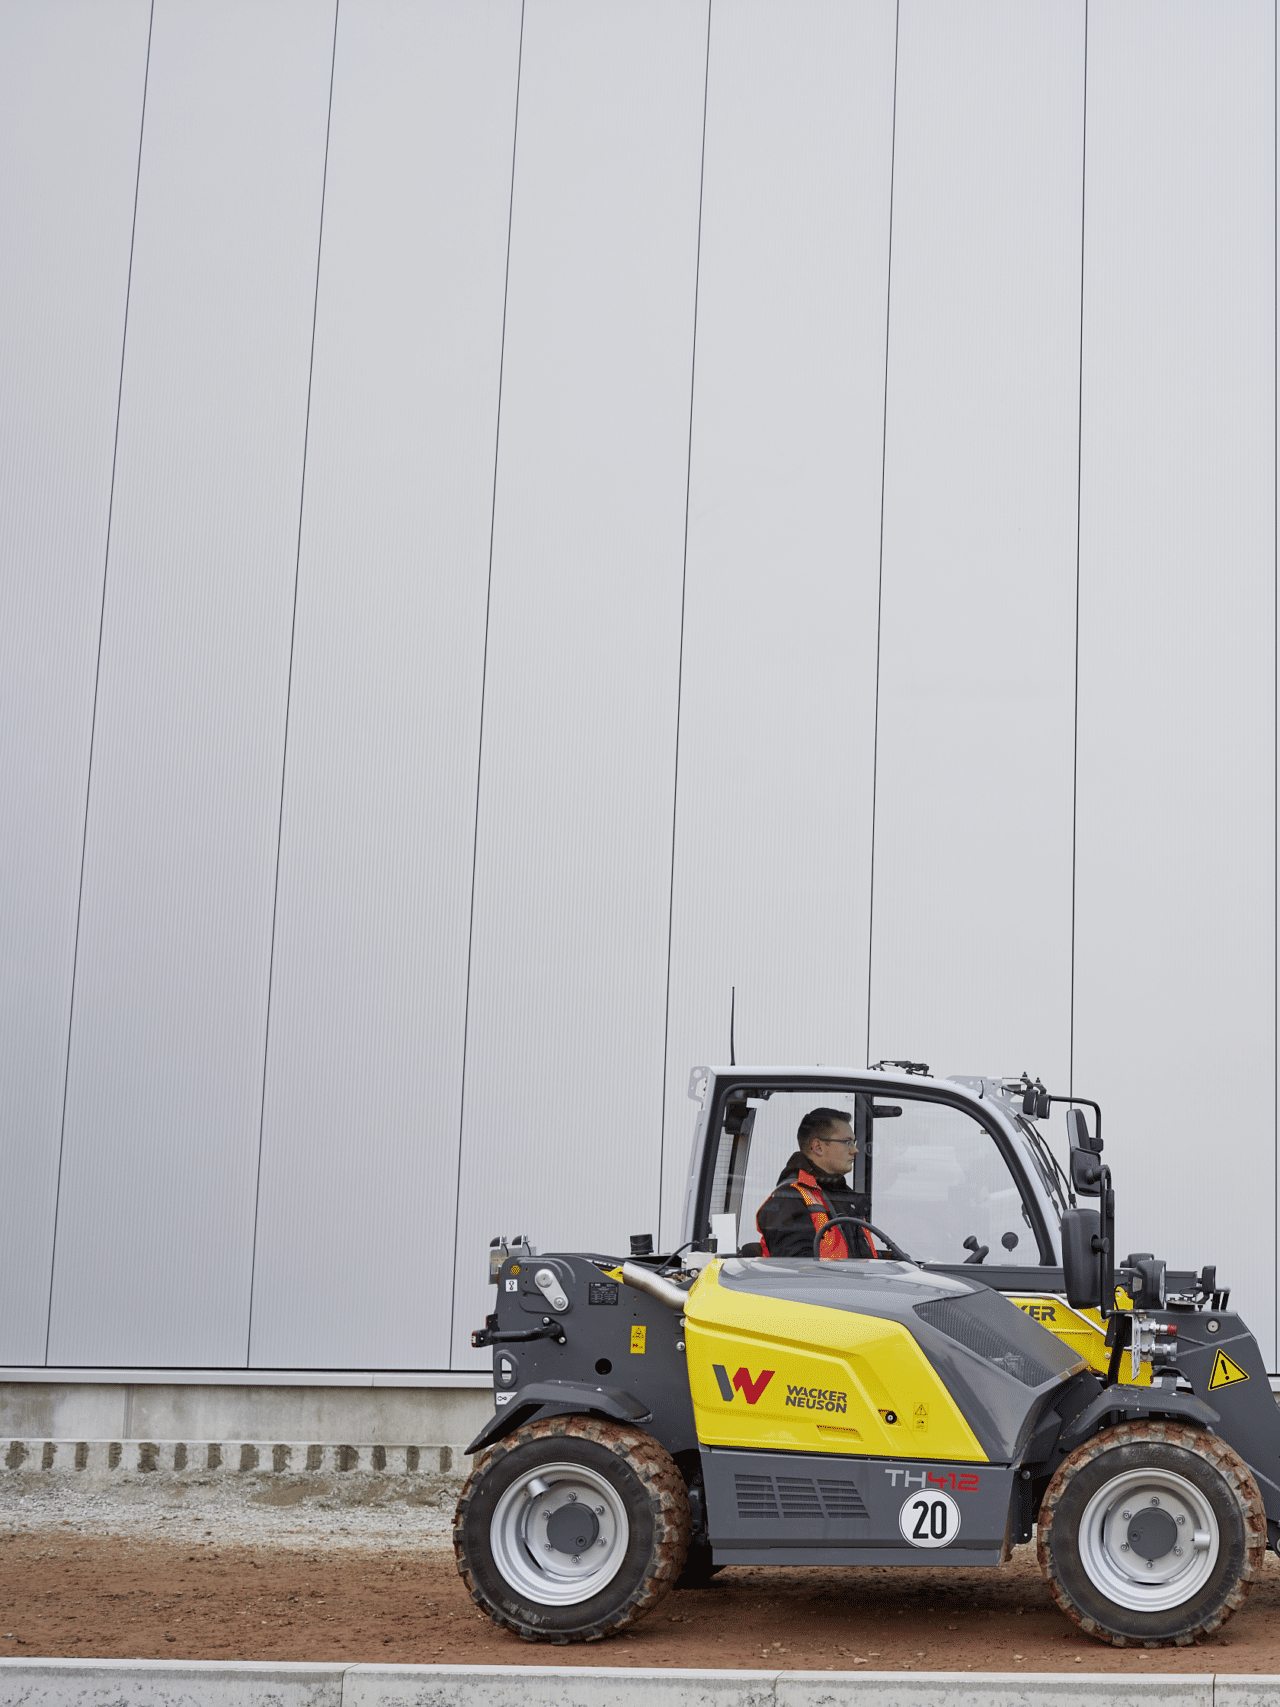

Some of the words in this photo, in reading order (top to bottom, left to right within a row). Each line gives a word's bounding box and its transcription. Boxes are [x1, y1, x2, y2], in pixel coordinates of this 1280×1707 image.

[787, 1385, 847, 1402] WACKER
[785, 1396, 847, 1413] NEUSON
[885, 1469, 979, 1491] TH412
[912, 1500, 947, 1539] 20
